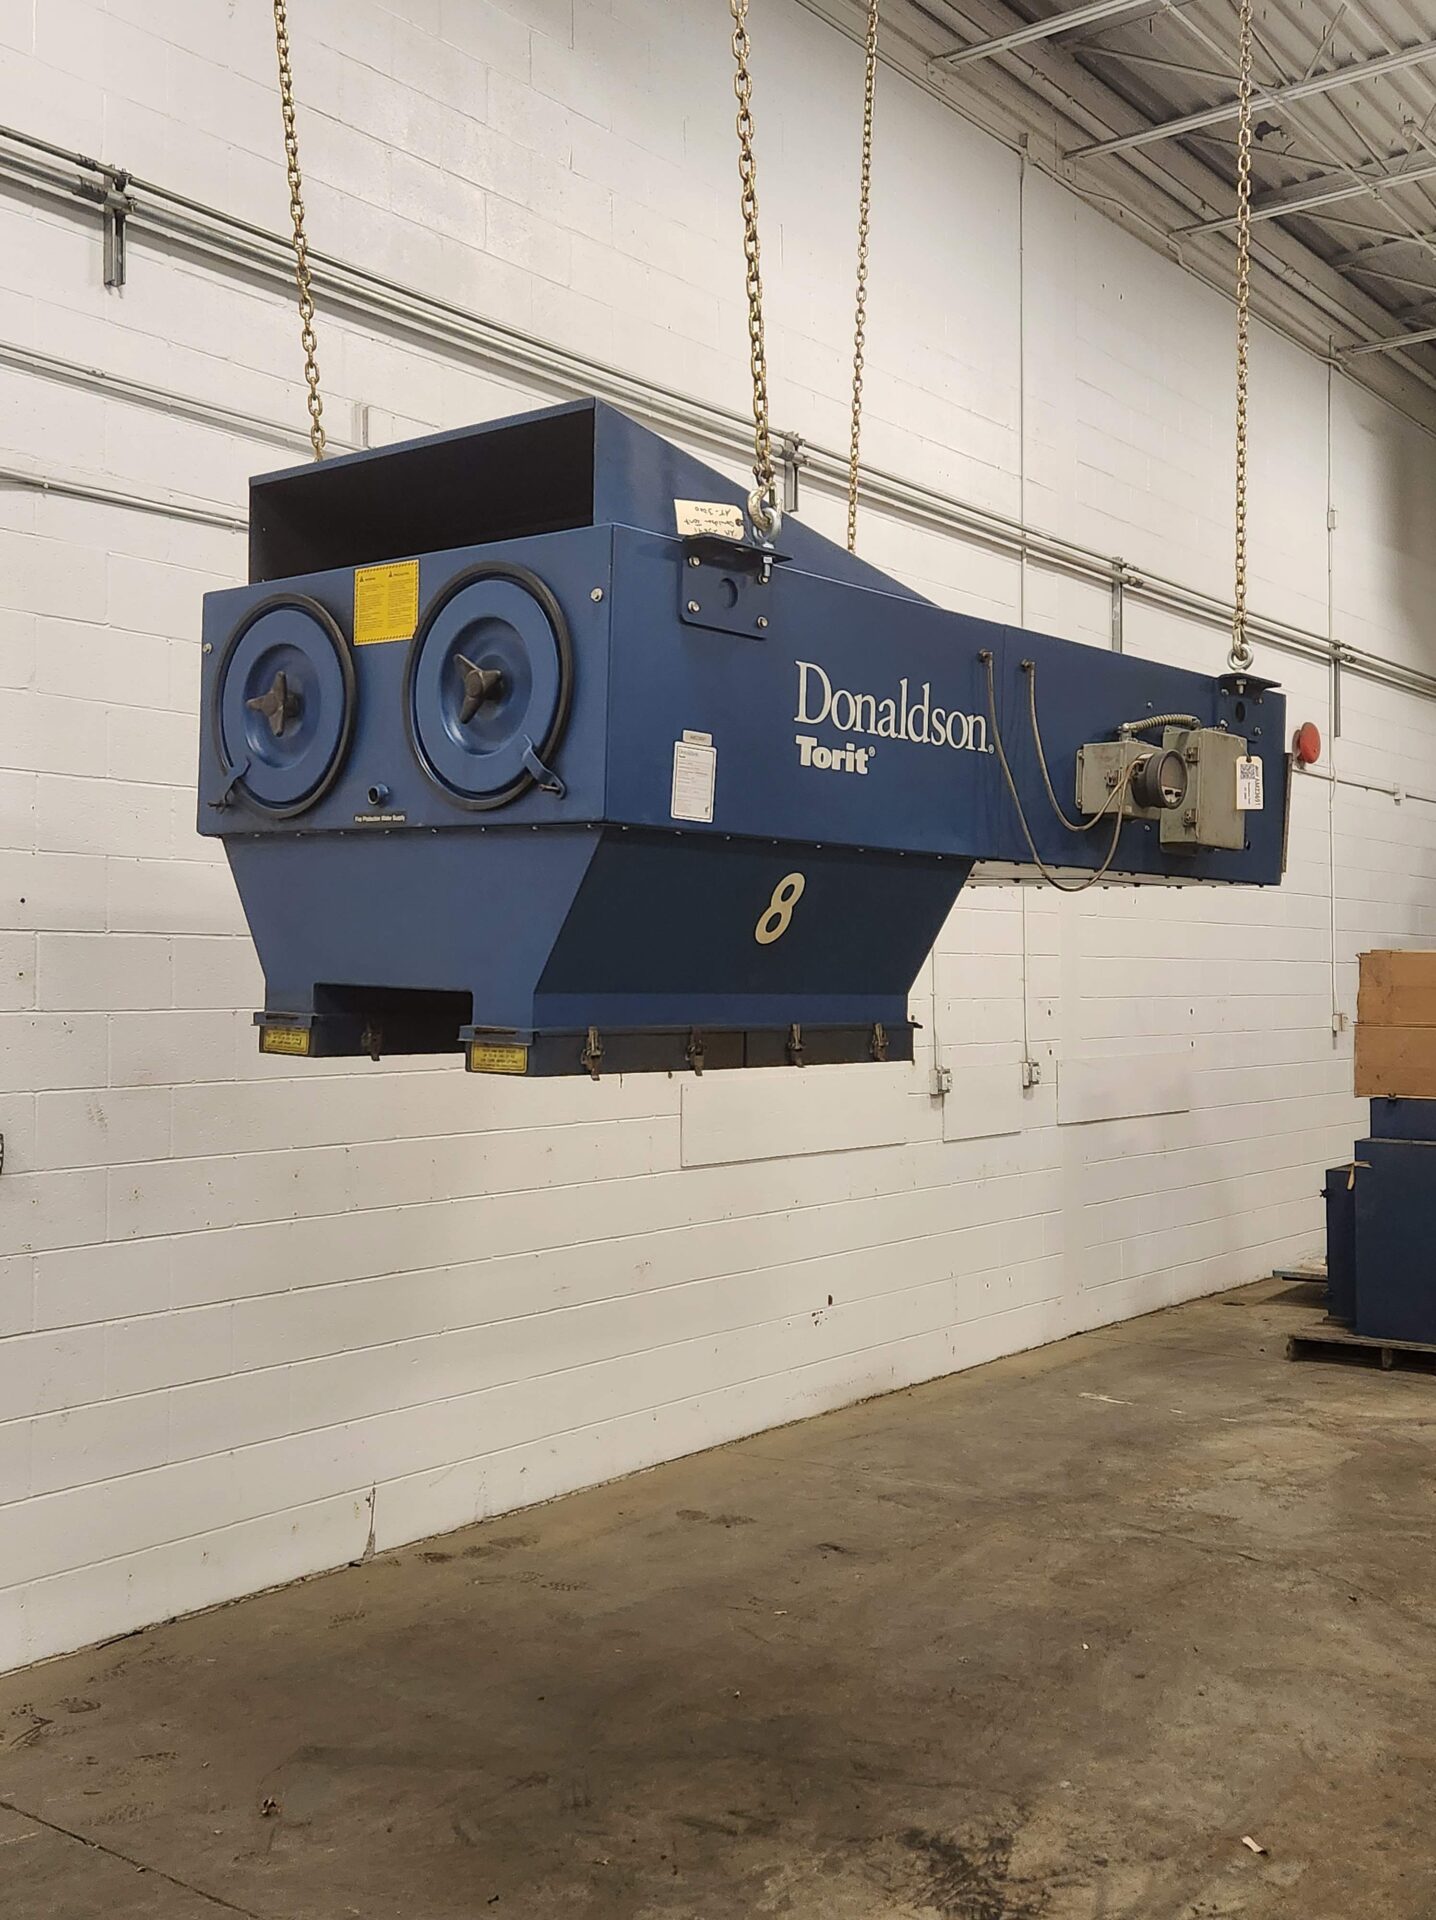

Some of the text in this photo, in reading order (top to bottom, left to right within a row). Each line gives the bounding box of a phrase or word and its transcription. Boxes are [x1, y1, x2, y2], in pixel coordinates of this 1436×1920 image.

[794, 660, 988, 753] Donaldson
[795, 734, 869, 775] Torit
[755, 872, 806, 945] 8
